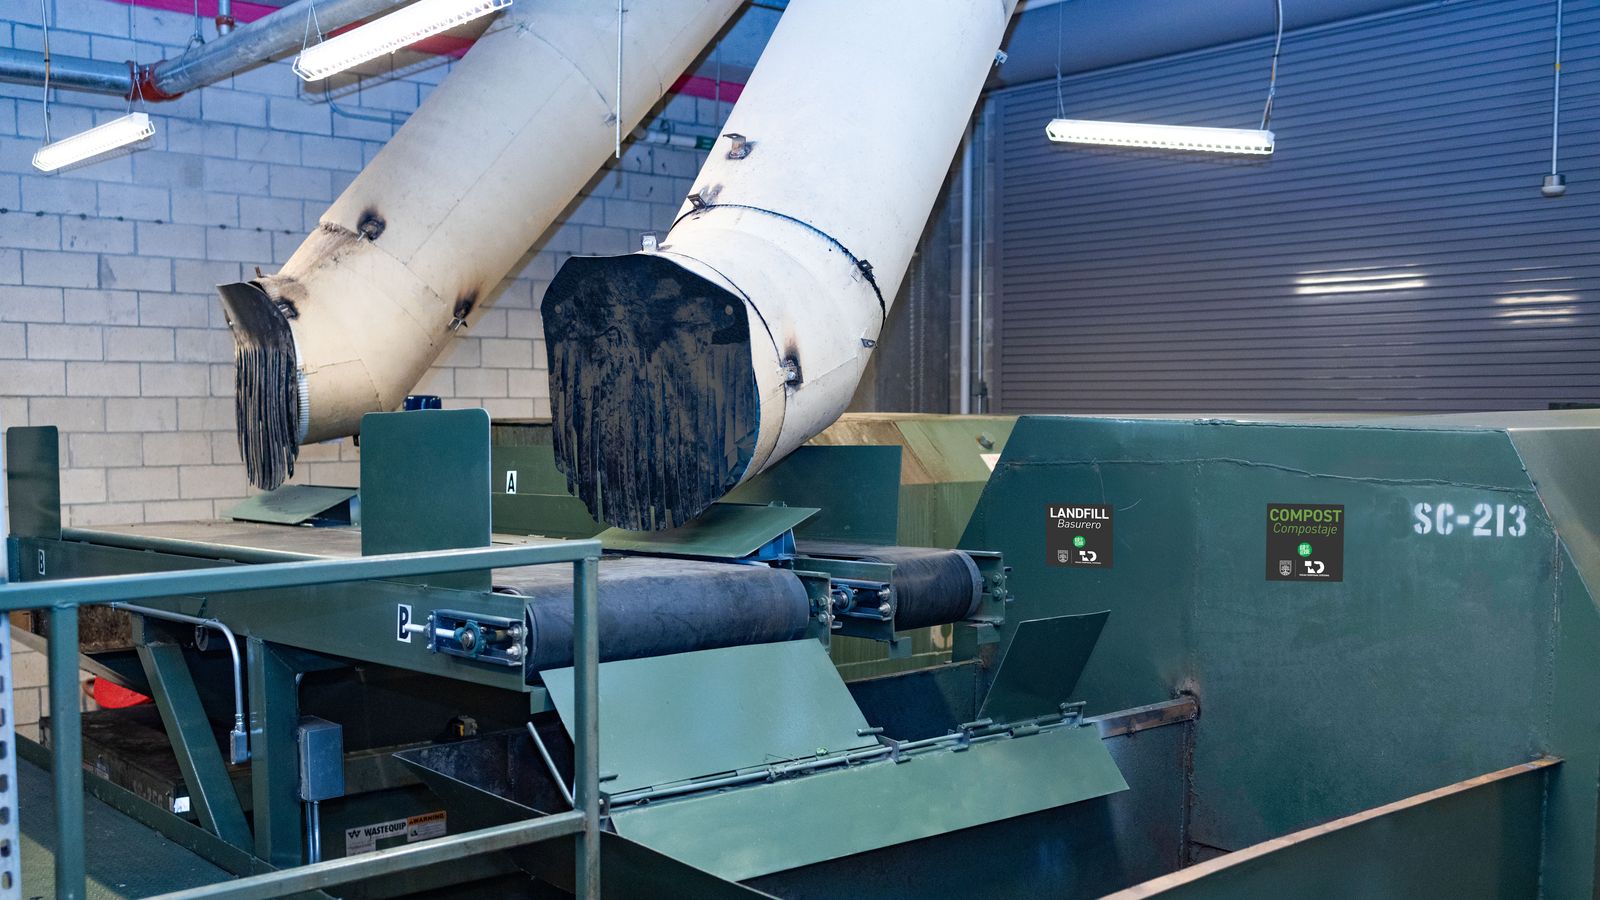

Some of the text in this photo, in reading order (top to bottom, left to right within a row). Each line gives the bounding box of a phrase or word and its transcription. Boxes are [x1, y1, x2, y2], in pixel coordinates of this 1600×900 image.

[508, 472, 515, 493] A
[1049, 507, 1110, 519] LANDFILL
[1269, 508, 1342, 522] COMPOST
[1413, 502, 1527, 537] SC-213
[1057, 518, 1102, 529] Basurero
[1273, 522, 1338, 537] Compostaje
[414, 812, 444, 824] WARNING
[364, 822, 407, 837] WASTEQUIP
